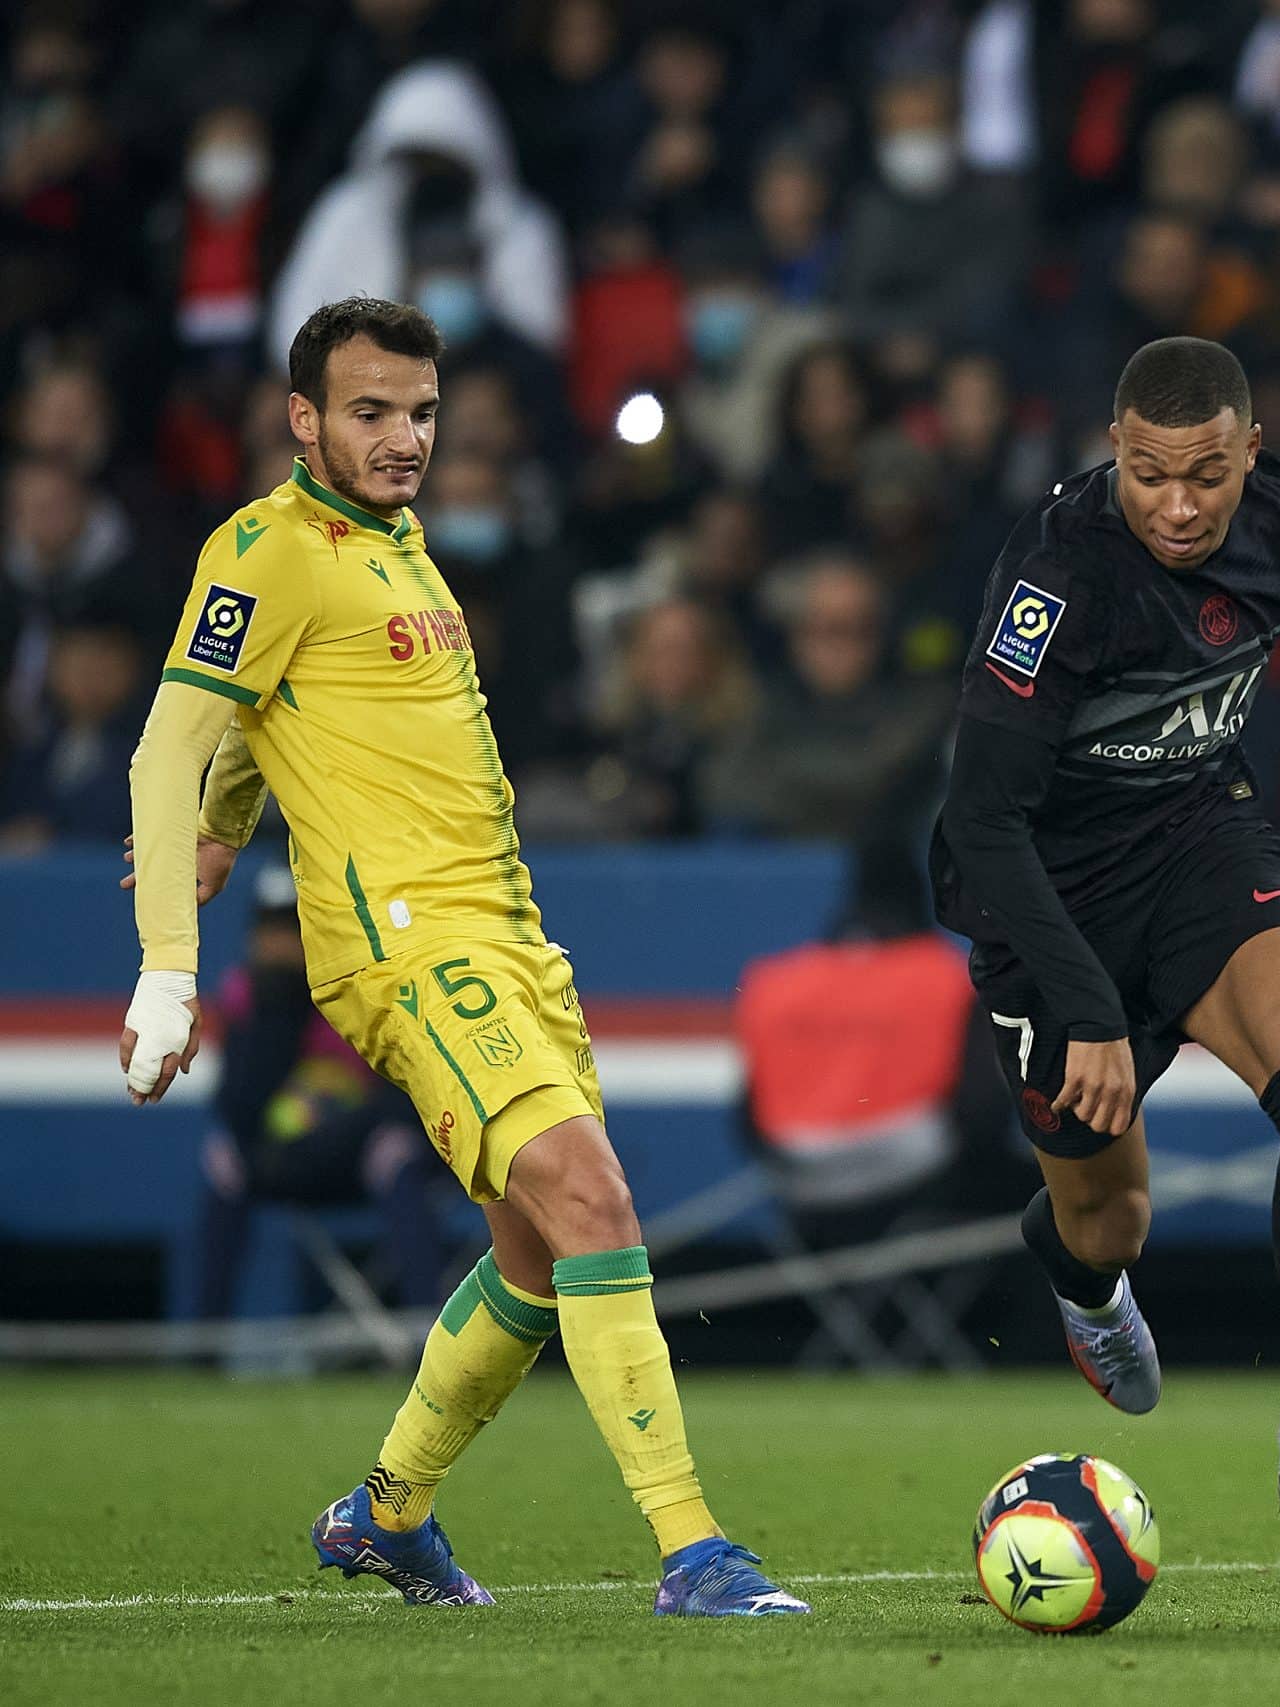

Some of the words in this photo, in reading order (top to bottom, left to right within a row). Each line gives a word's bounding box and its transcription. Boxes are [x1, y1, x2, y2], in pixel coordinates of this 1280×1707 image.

[199, 635, 229, 651] LIGUE
[1002, 632, 1030, 653] LIGUE
[193, 644, 213, 657] Uber
[212, 651, 233, 664] Eats
[1088, 742, 1163, 762] ACCOR
[1167, 741, 1209, 761] LIVE
[430, 957, 498, 1020] 5
[476, 1016, 508, 1034] NANTES
[991, 1011, 1034, 1082] 7
